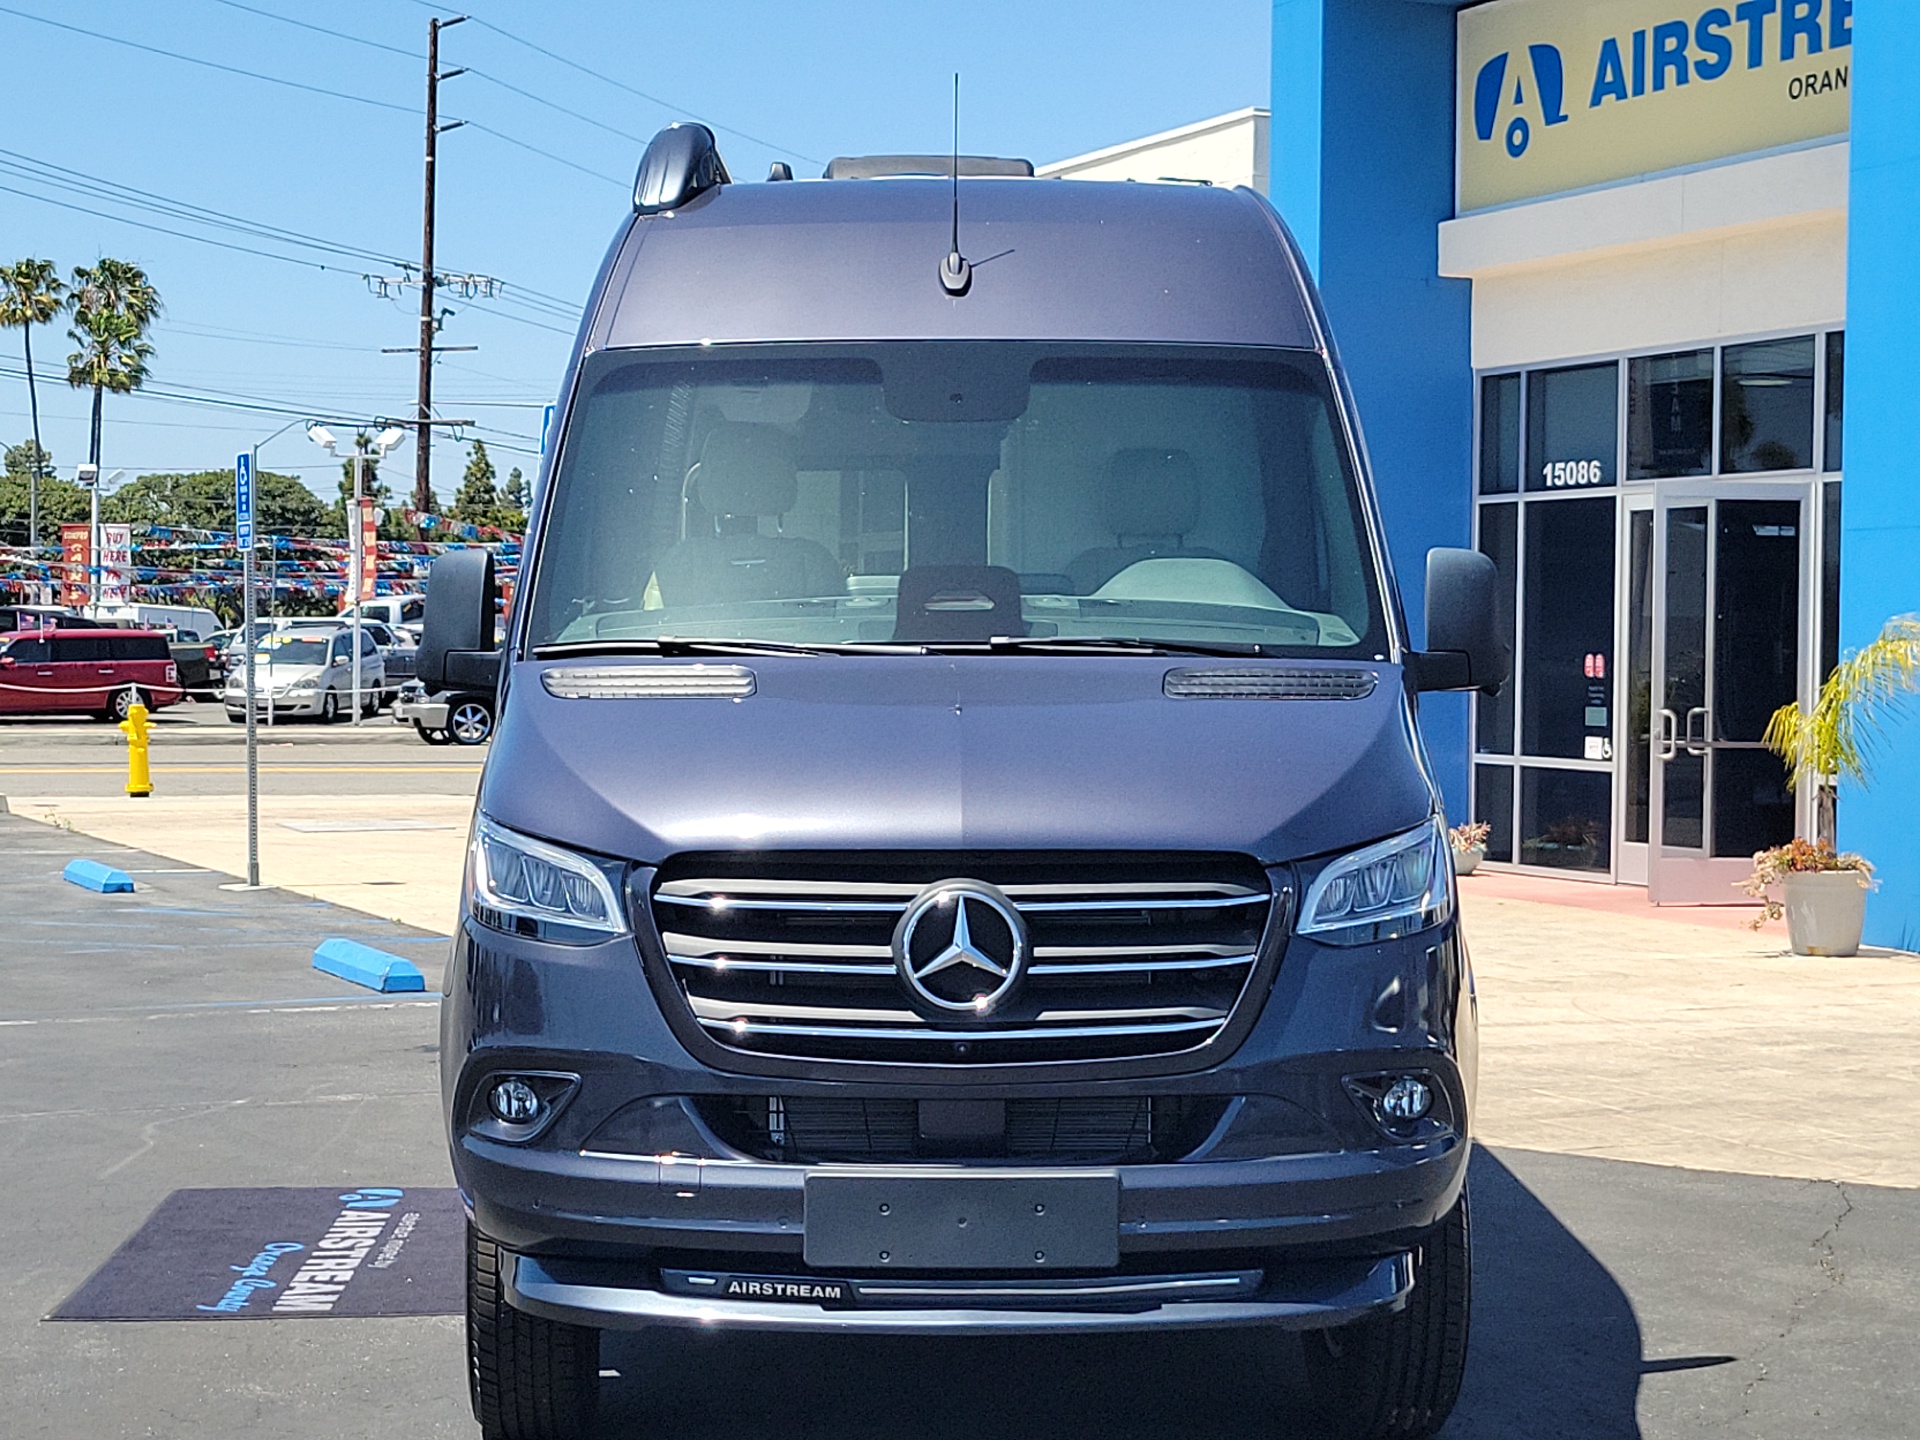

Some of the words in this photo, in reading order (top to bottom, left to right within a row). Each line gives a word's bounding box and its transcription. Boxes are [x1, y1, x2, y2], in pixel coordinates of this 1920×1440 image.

[1788, 65, 1848, 99] ORAN
[1543, 460, 1602, 487] 15086
[103, 550, 128, 562] HERE
[229, 1242, 304, 1277] Orange
[272, 1210, 391, 1311] AIRSTREAM
[196, 1279, 277, 1312] County
[728, 1281, 841, 1299] AIRSTREAM
